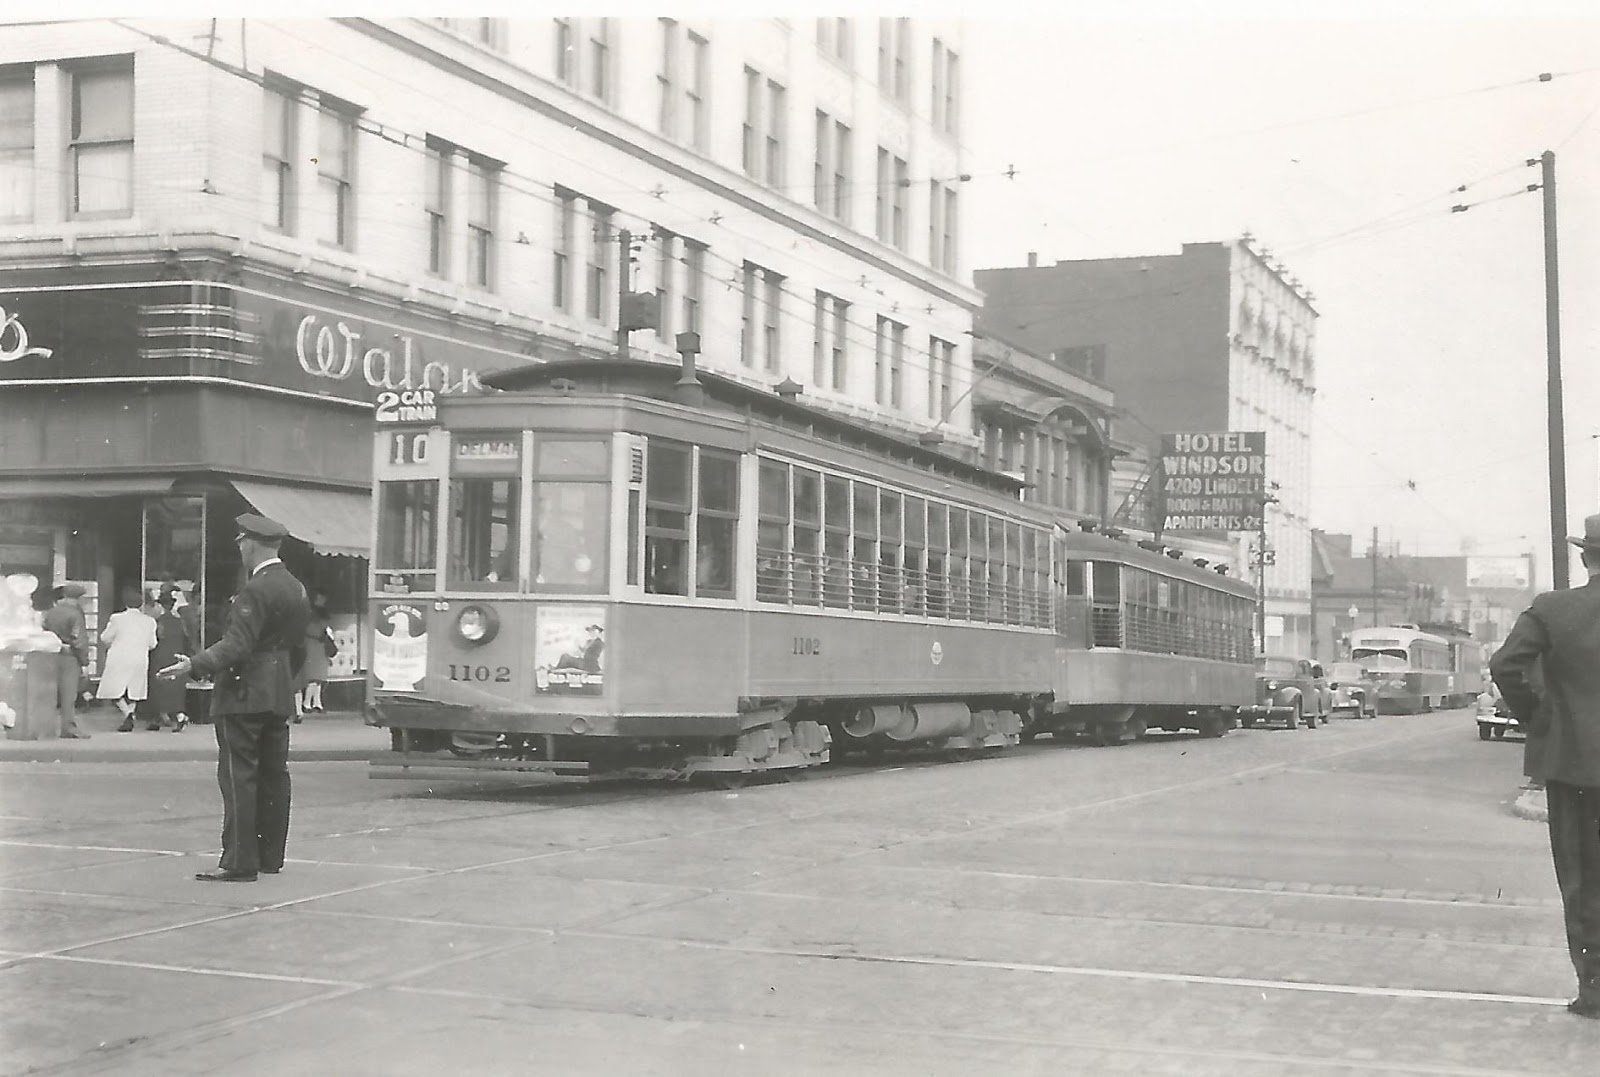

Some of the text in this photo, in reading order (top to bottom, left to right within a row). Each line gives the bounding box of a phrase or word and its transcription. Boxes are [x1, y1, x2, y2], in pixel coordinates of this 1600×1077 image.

[375, 390, 435, 421] 2 CAR
[399, 405, 437, 421] TRAIN
[395, 434, 429, 464] 10
[1175, 433, 1252, 453] HOTEL
[1163, 455, 1264, 476] WINDSOR
[1163, 515, 1241, 530] APARTMENTS
[792, 636, 821, 656] 1102
[448, 664, 511, 683] 1102
